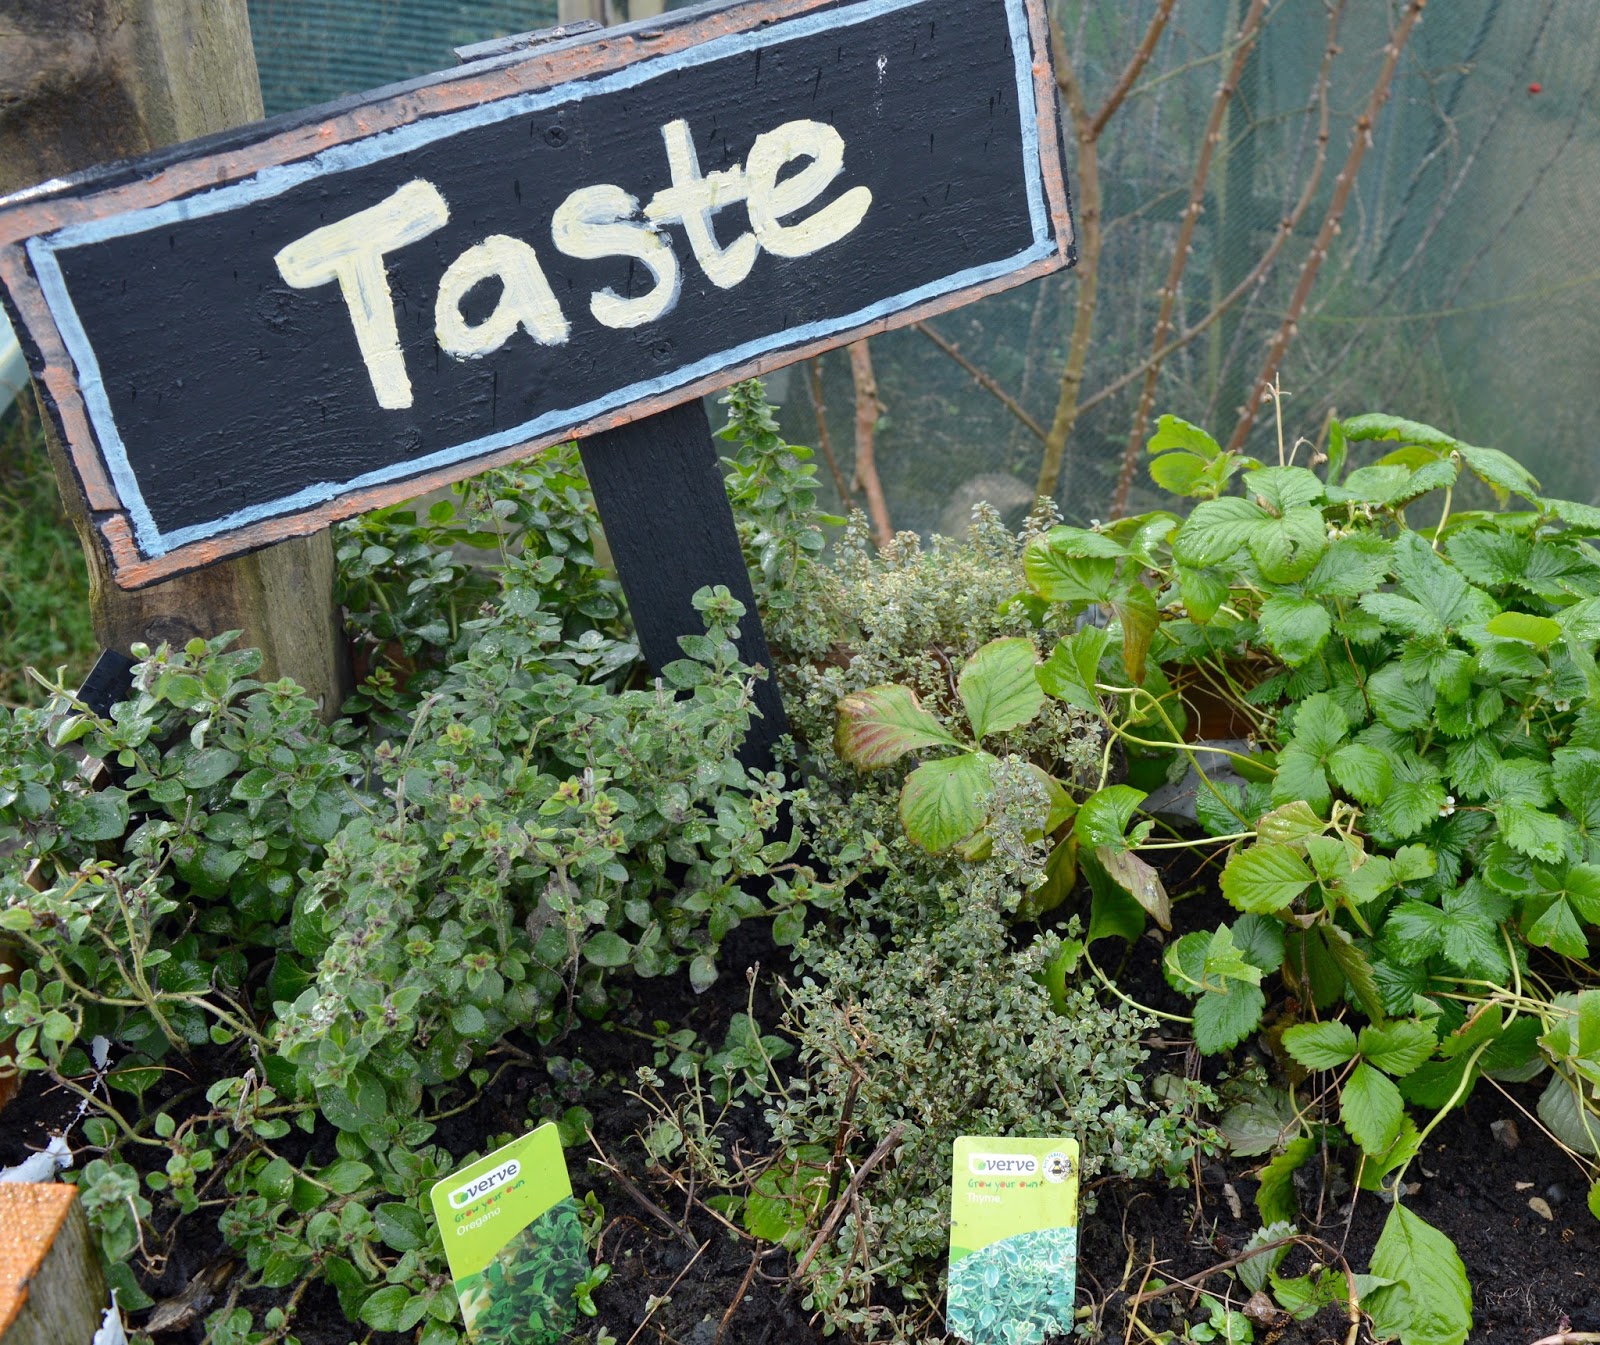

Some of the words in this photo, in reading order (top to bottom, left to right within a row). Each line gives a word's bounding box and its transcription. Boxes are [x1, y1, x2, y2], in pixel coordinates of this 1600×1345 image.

[274, 118, 873, 410] Taste
[986, 1160, 1035, 1171] verve
[467, 1164, 517, 1197] verve
[968, 1178, 992, 1189] Grow
[995, 1181, 1015, 1192] your
[454, 1206, 479, 1223] Grow
[482, 1191, 502, 1212] your
[506, 1179, 525, 1194] own
[967, 1193, 1001, 1204] Thyme
[456, 1207, 501, 1236] Oregano
